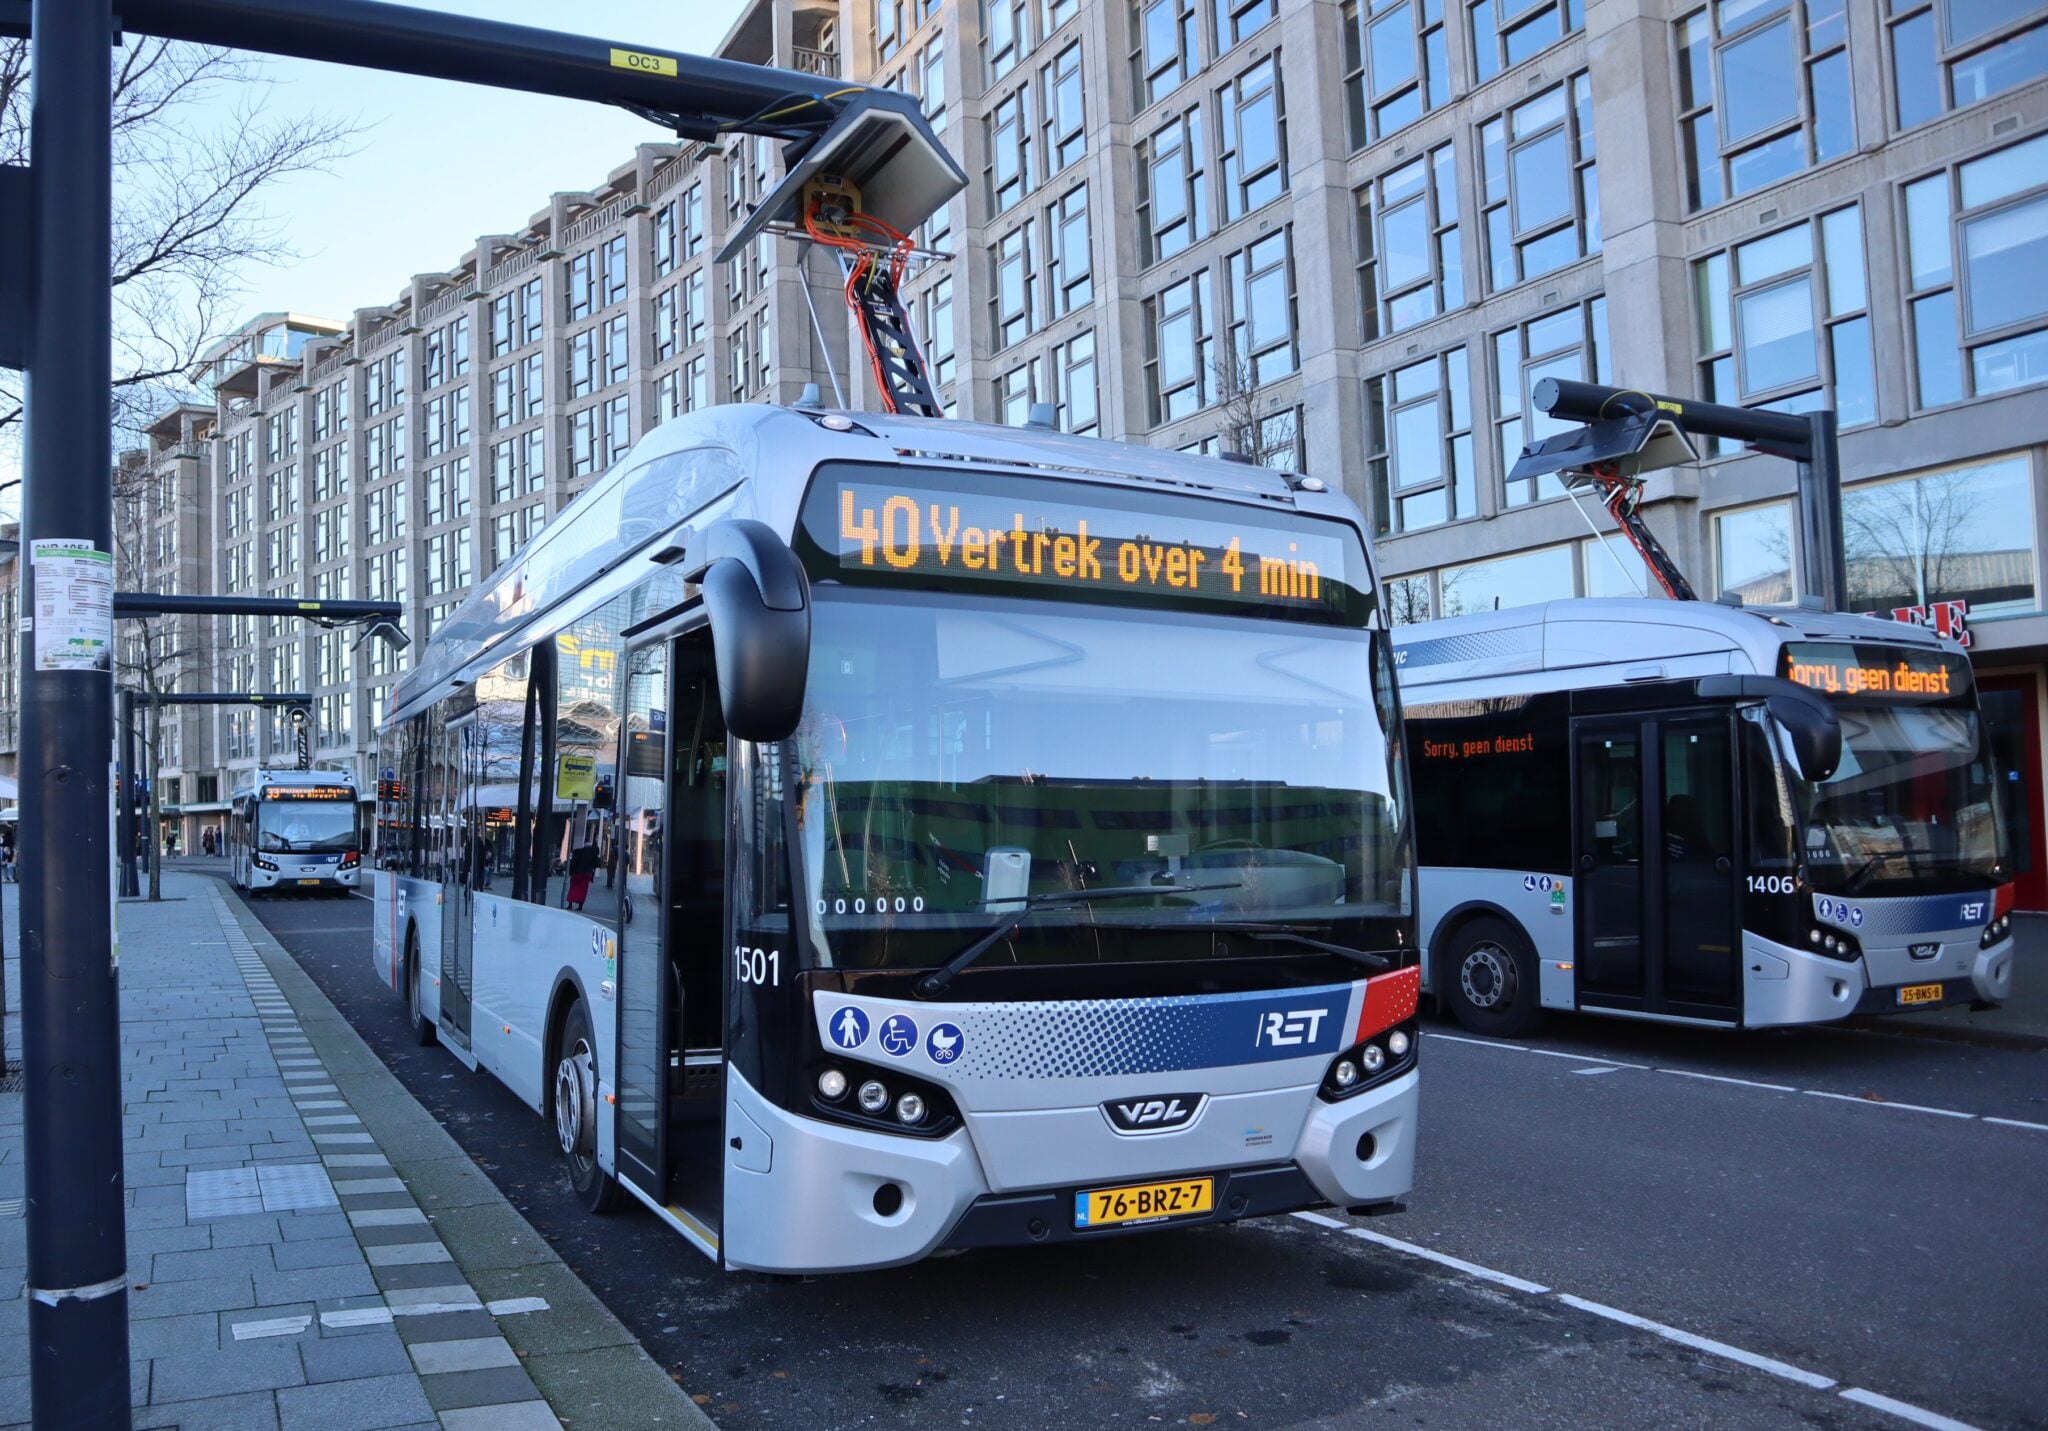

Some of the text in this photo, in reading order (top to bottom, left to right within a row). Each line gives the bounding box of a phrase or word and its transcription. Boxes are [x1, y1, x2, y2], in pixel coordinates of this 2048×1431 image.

[628, 54, 660, 71] OC3
[842, 489, 1320, 600] 40 Vertrek over 4 min
[1845, 665, 1890, 695] geen
[1894, 661, 1950, 694] dienst
[1463, 741, 1490, 758] geen
[1495, 734, 1534, 753] dienst
[266, 787, 280, 799] 33
[1746, 875, 1795, 895] 1406
[1959, 902, 1985, 922] RET
[733, 945, 780, 987] 1501
[1256, 1008, 1329, 1048] RET
[1118, 1099, 1188, 1124] VDL
[1077, 1183, 1204, 1221] NL 76-BRZ-7
